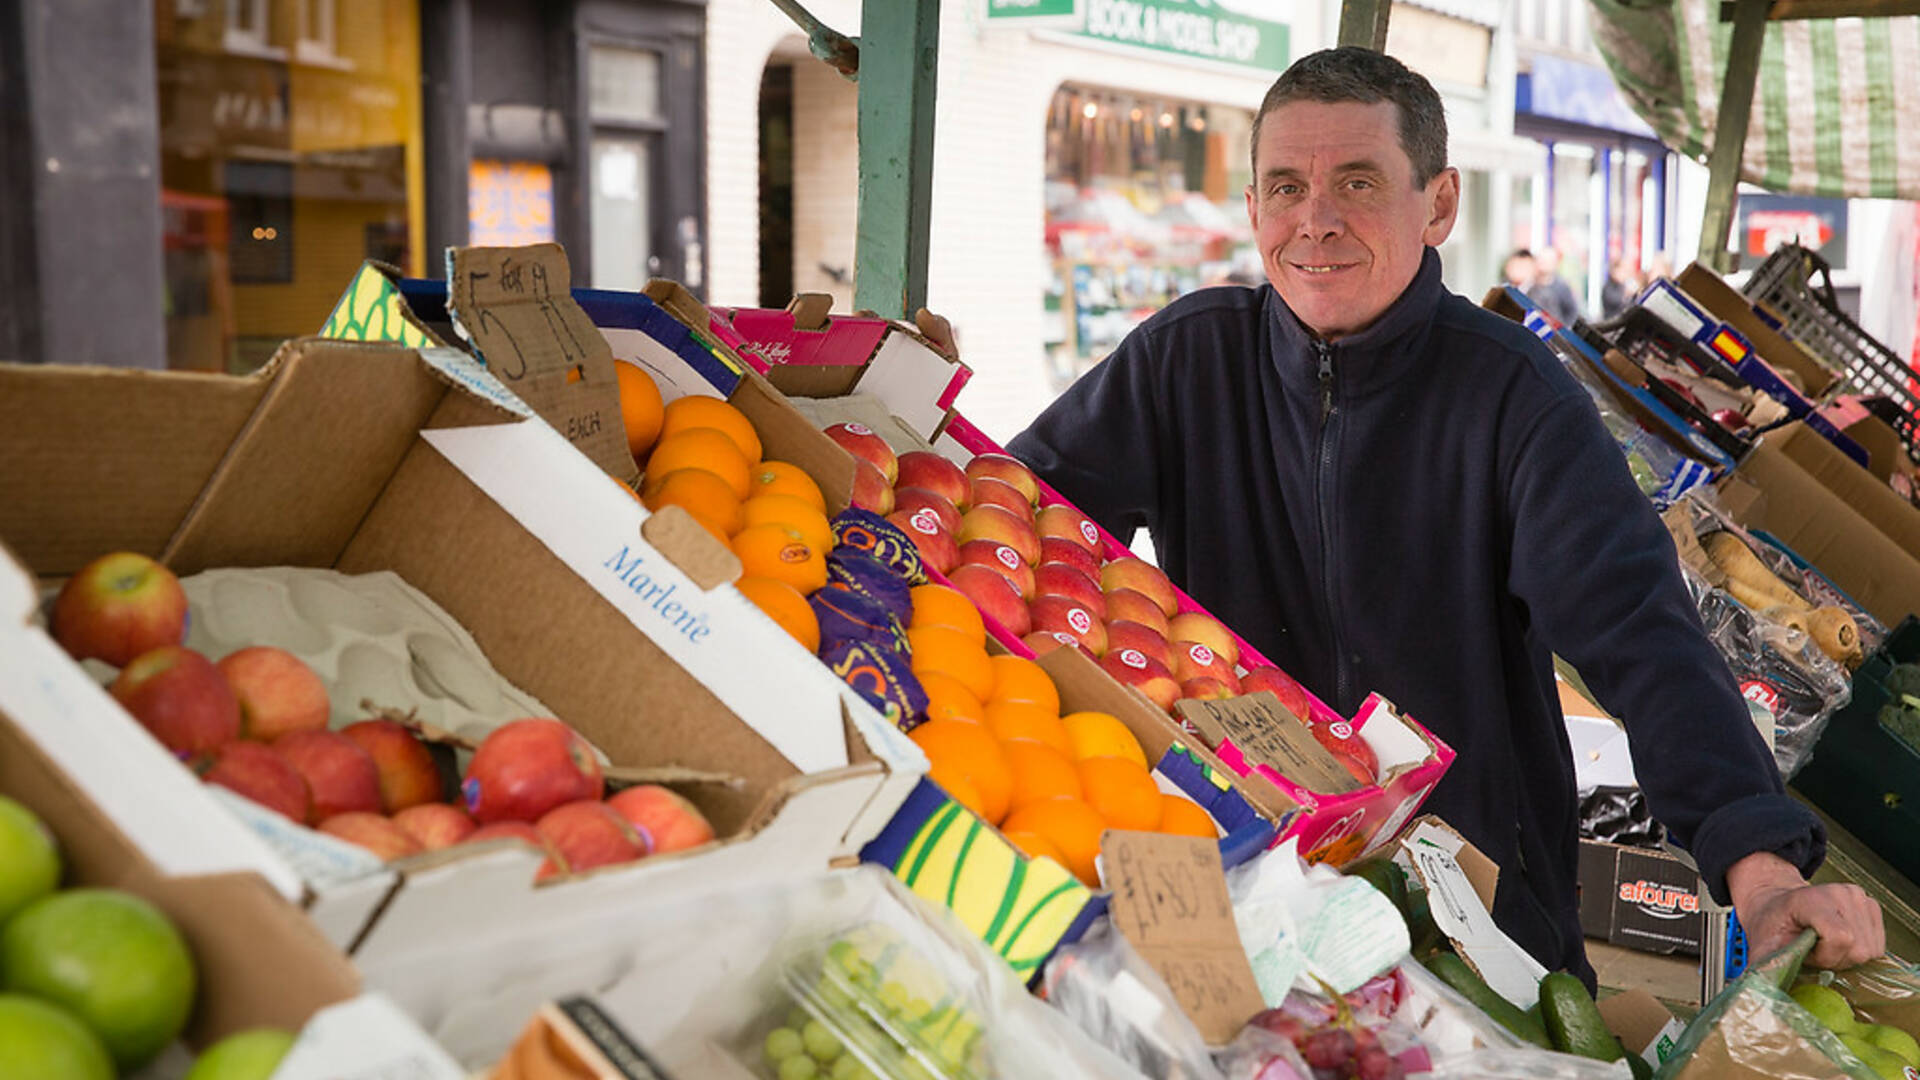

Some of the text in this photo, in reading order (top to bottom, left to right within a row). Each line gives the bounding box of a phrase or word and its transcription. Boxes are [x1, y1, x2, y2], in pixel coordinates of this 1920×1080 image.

[1088, 0, 1144, 40] BOOK
[1157, 8, 1216, 56] MODEL
[1216, 19, 1259, 61] SHOP
[567, 411, 601, 442] EACH
[603, 545, 710, 645] Marlene
